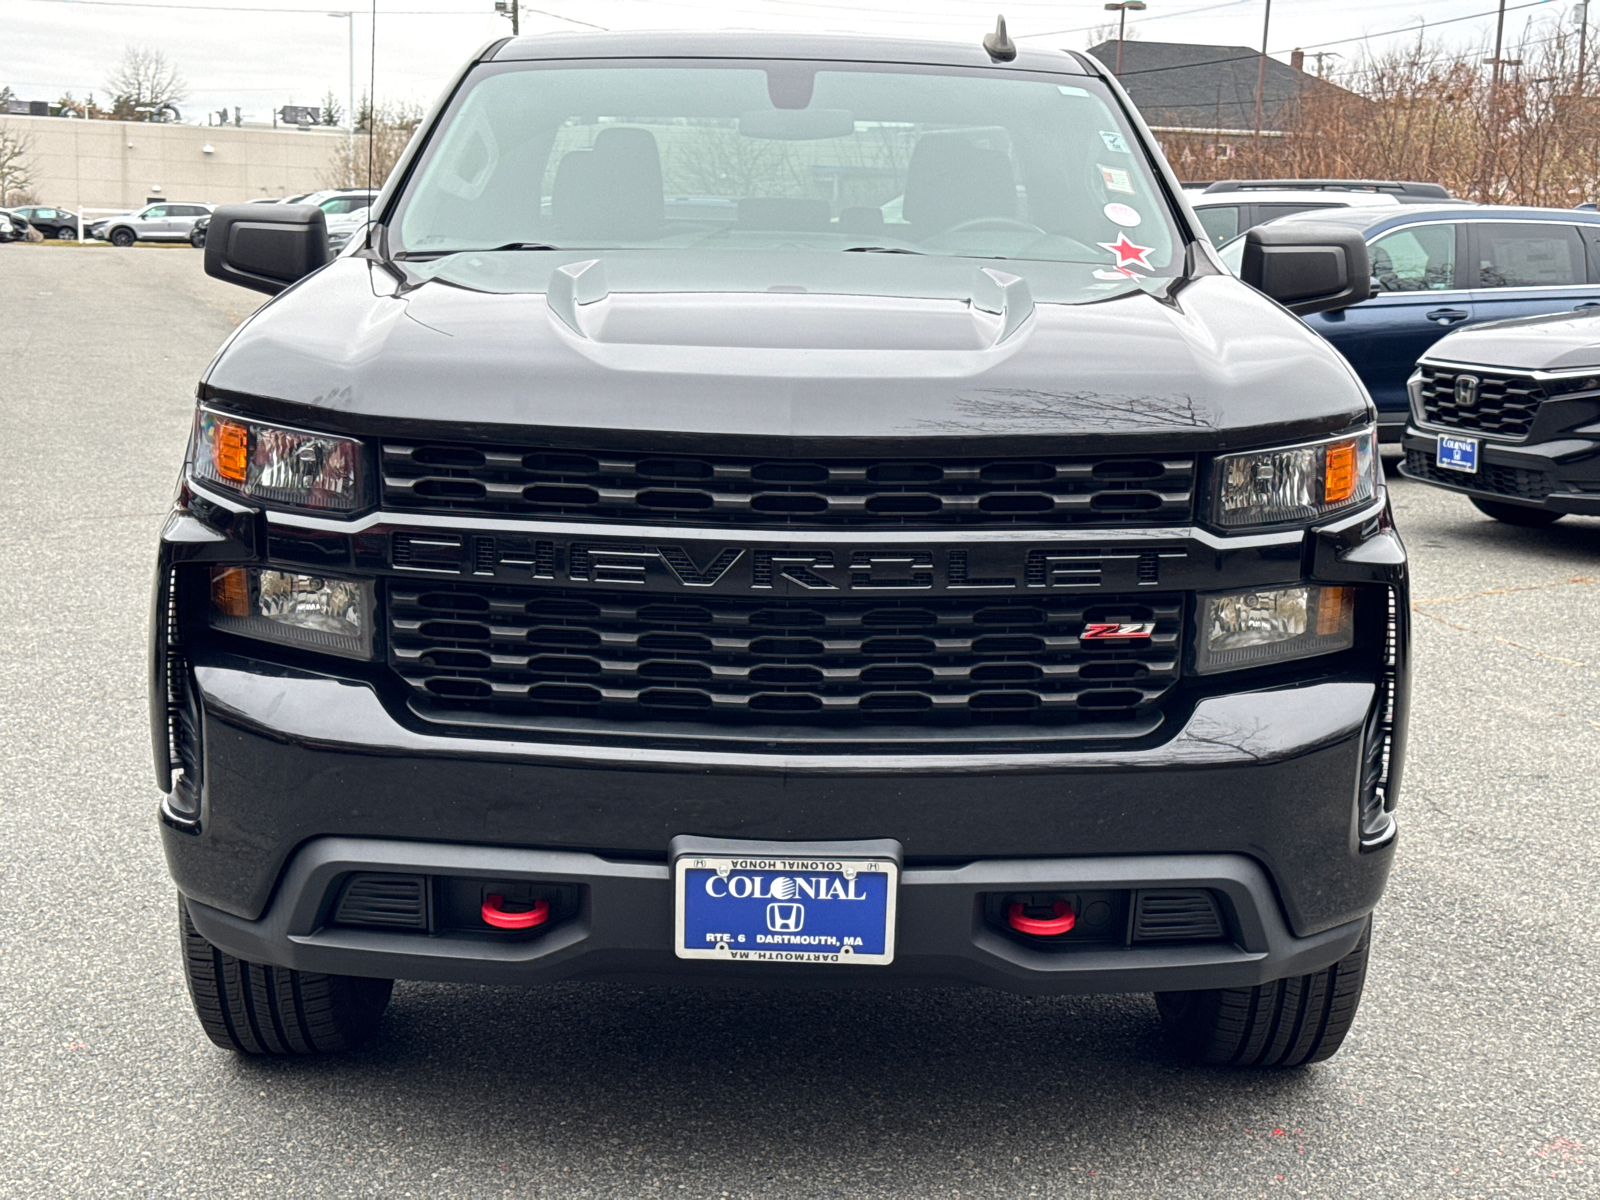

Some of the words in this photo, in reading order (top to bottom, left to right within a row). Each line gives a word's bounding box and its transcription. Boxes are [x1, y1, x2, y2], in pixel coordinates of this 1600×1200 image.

[391, 531, 1189, 590] CHEVROLET
[1079, 623, 1156, 639] Z71
[731, 860, 776, 869] HONDA
[780, 860, 843, 871] COLONIAL
[705, 875, 867, 900] COLONIAL
[706, 933, 735, 943] RTE.
[737, 934, 746, 943] 6
[756, 934, 841, 947] DARTMOUTH,
[843, 936, 864, 946] MA
[730, 951, 750, 959] MA
[754, 952, 839, 962] DARTMOUTH,
